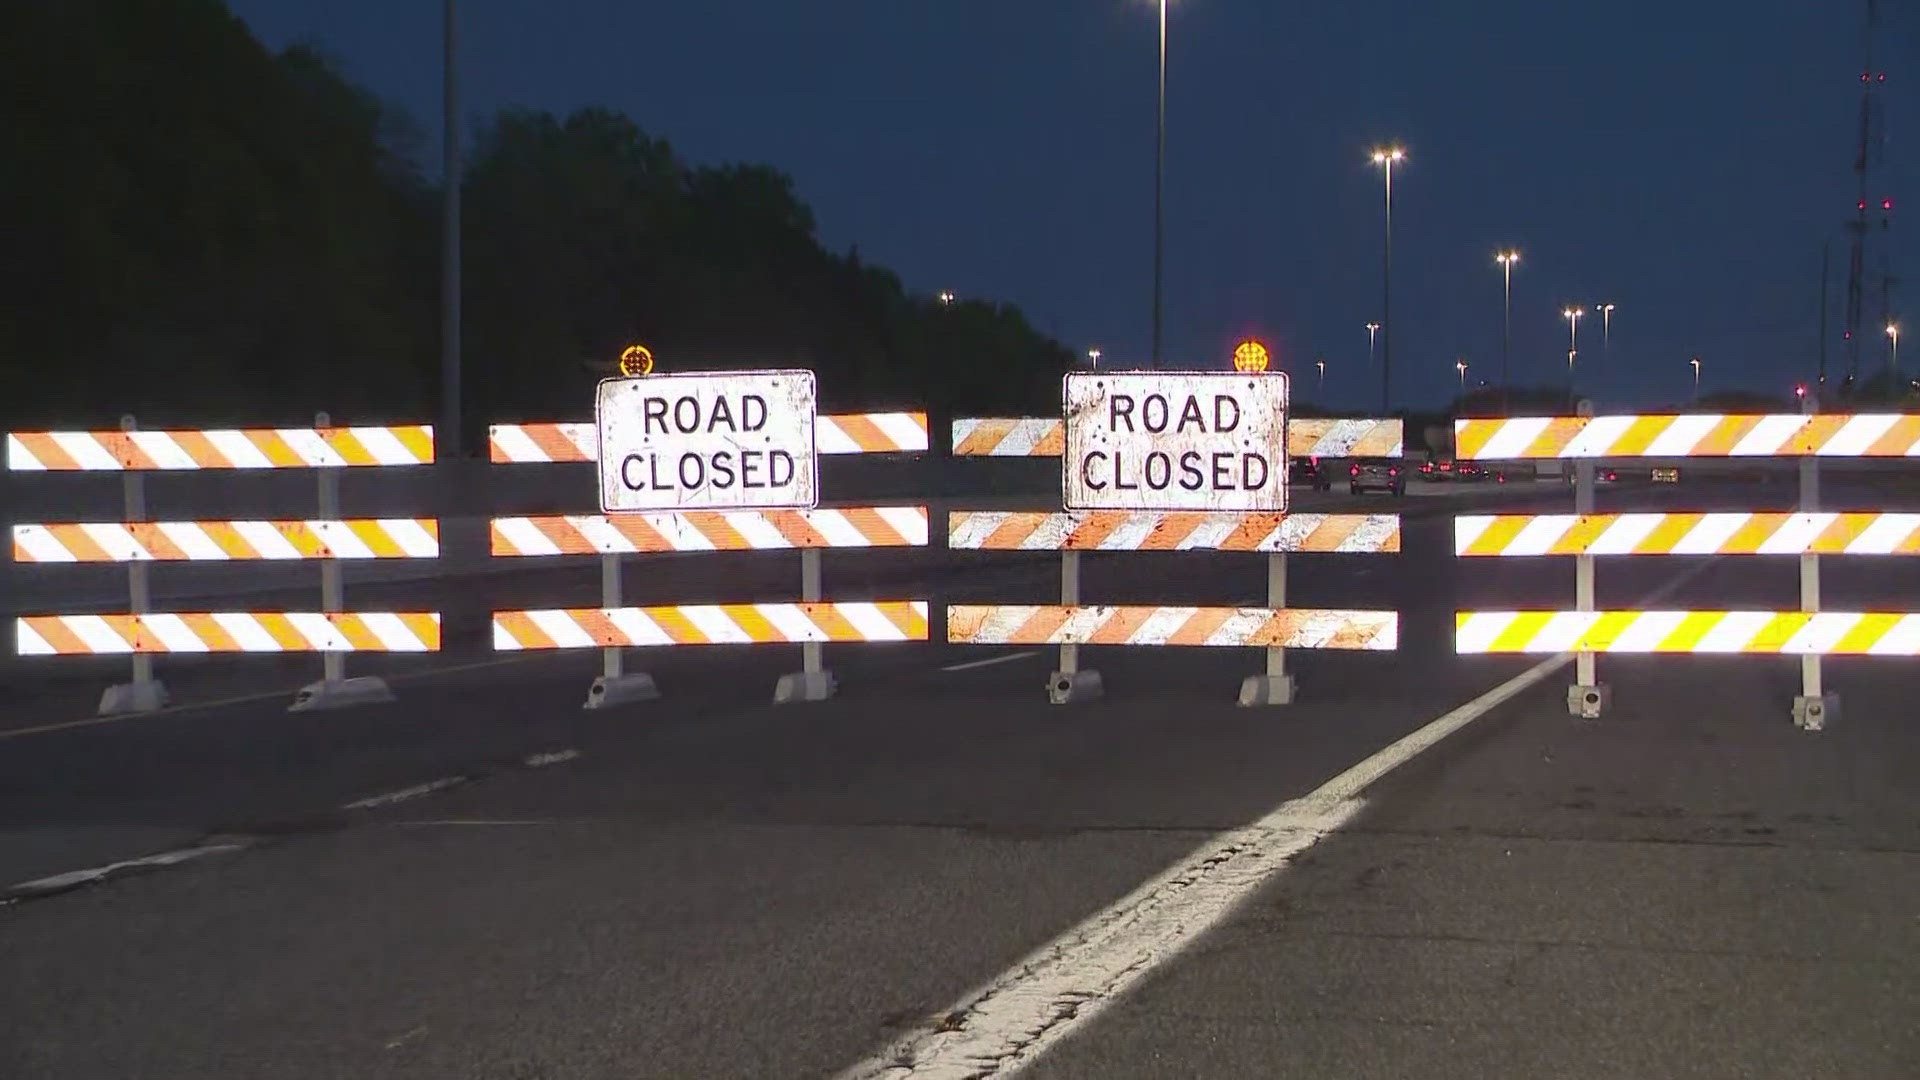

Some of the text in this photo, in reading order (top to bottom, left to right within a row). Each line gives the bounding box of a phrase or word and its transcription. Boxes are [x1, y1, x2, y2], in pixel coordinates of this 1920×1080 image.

[643, 394, 768, 435] ROAD
[1109, 393, 1241, 434] ROAD
[621, 449, 795, 491] CLOSED
[1082, 450, 1269, 491] CLOSED
